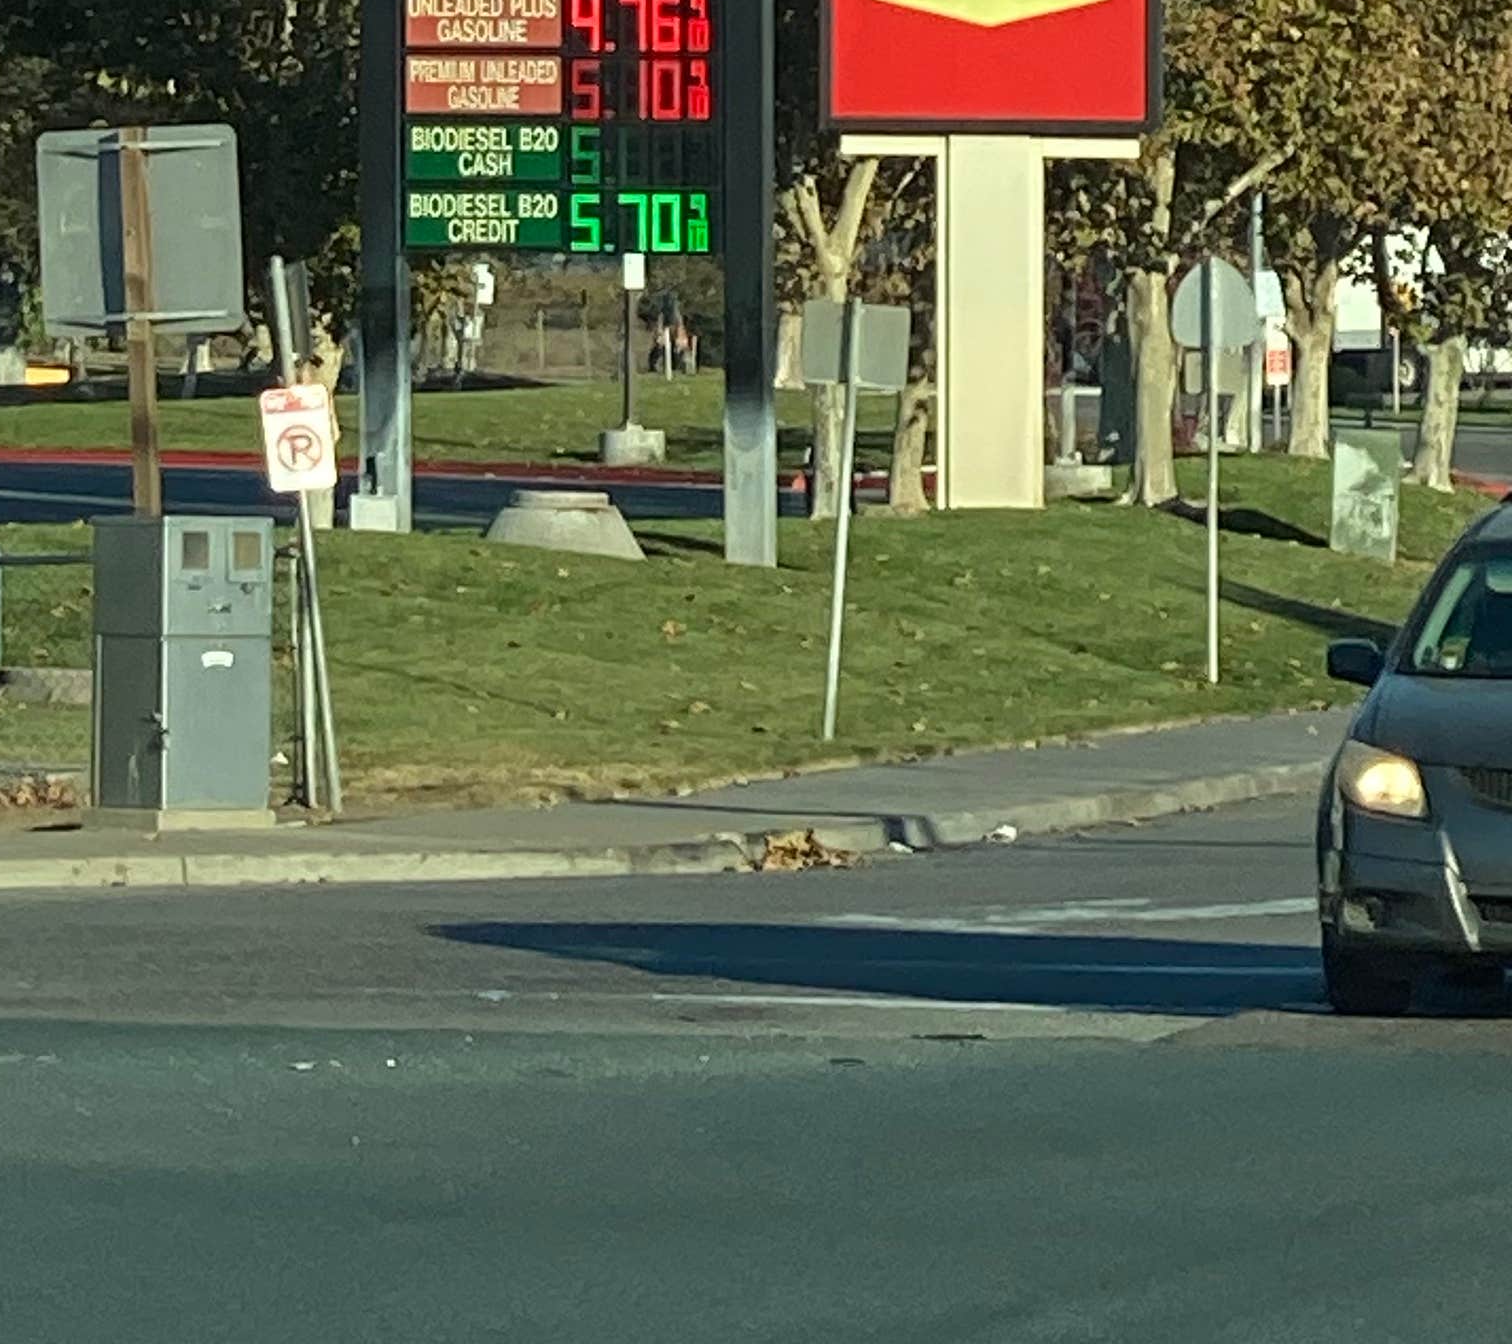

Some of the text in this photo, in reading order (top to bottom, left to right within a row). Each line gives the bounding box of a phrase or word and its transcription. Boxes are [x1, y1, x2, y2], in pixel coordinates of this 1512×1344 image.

[437, 20, 528, 43] GASOLINE
[410, 60, 557, 84] PREMIUM UNLEADED
[447, 86, 520, 110] GASOLINE
[411, 126, 559, 152] BIODIESEL B20
[458, 153, 513, 177] CASH
[409, 193, 558, 218] BIODIESEL B20
[448, 219, 520, 243] CREDIT
